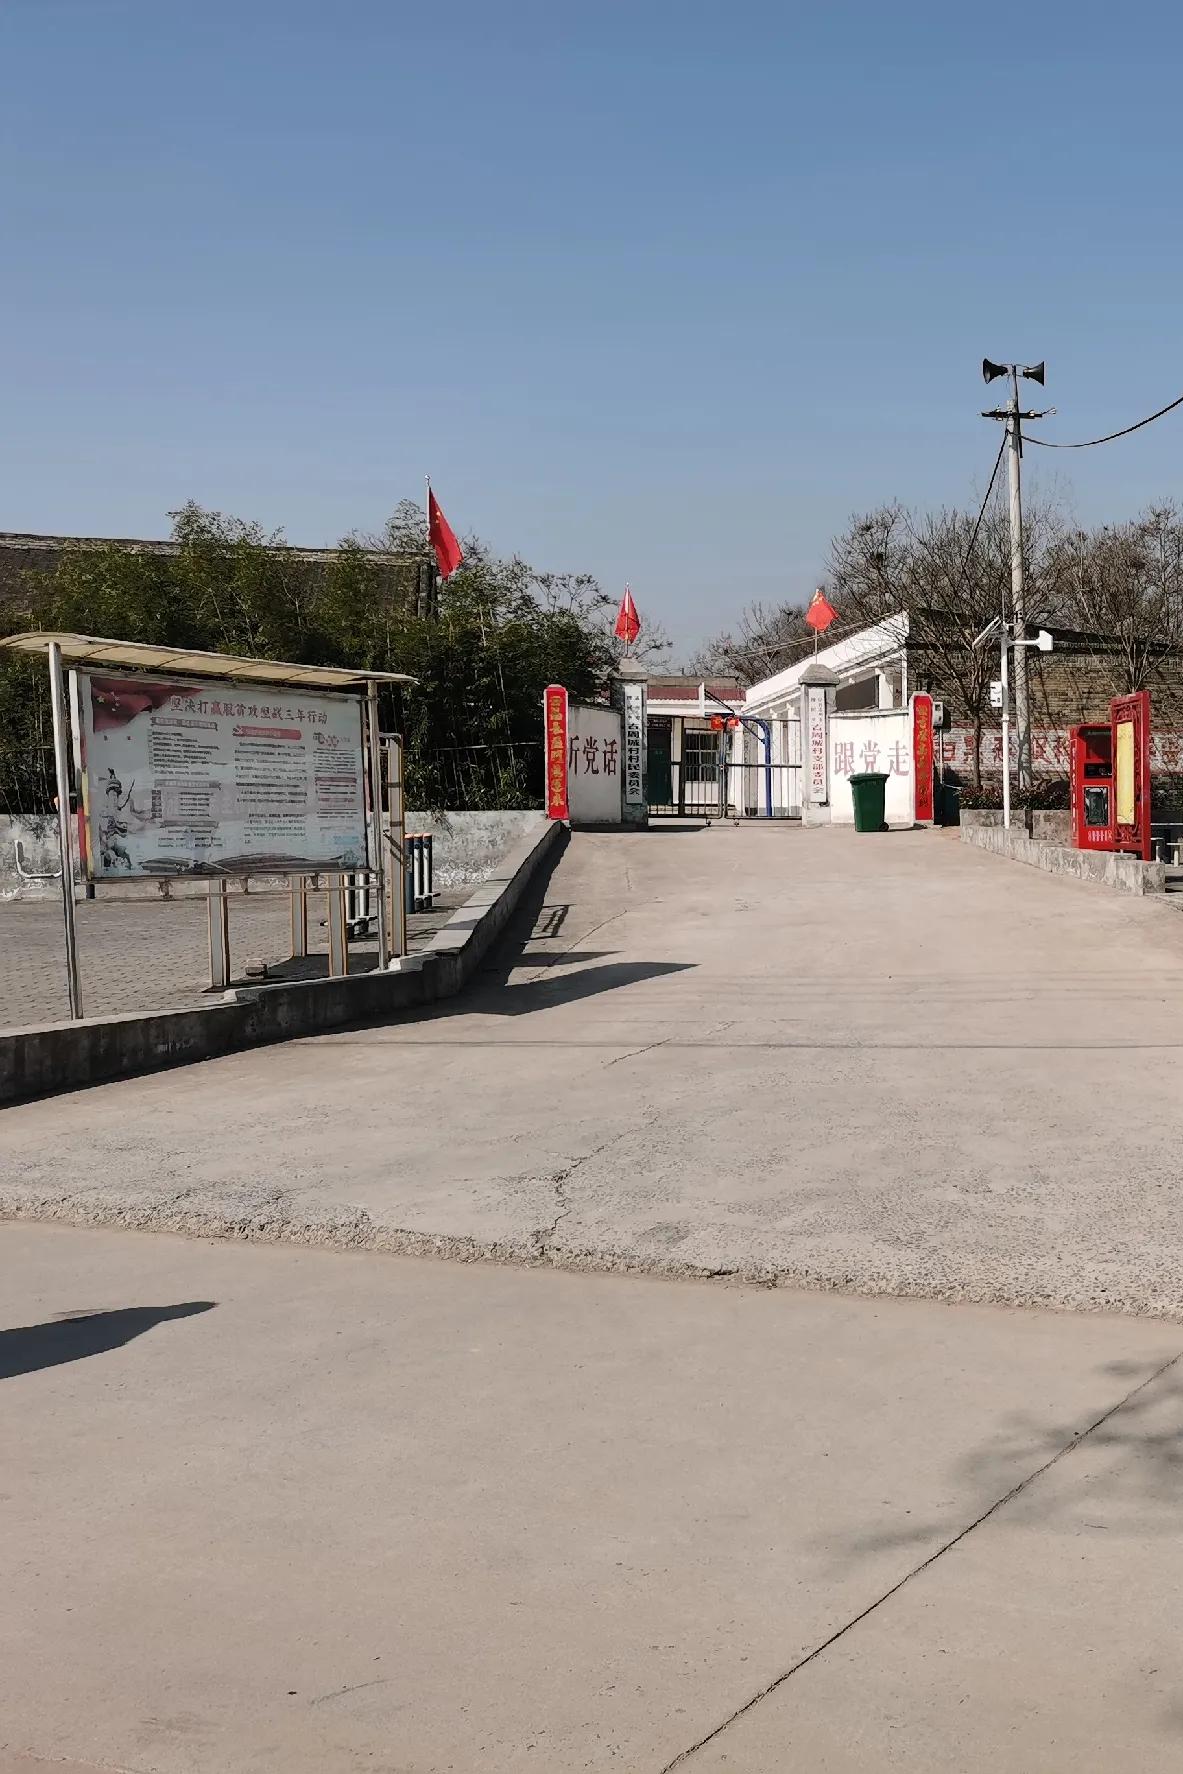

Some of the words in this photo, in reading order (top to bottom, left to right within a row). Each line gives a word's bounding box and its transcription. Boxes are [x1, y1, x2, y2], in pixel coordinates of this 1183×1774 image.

[170, 695, 328, 724] 坚决打赢脱贫攻坚战三年行动
[834, 740, 910, 777] 跟党走
